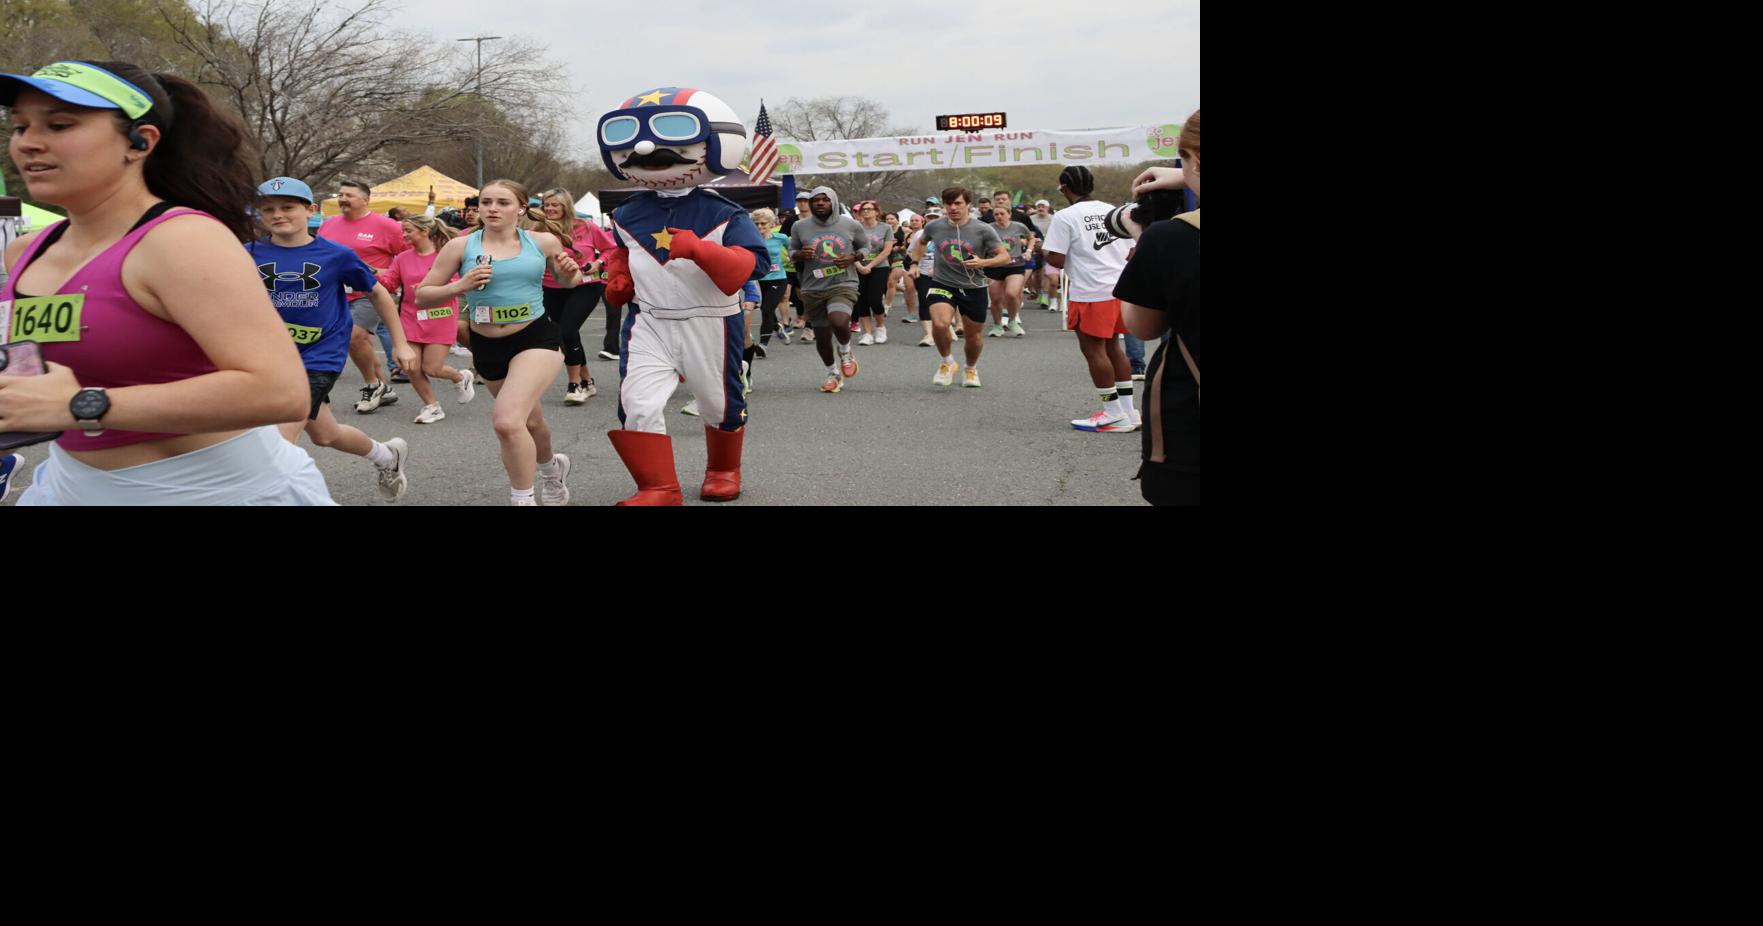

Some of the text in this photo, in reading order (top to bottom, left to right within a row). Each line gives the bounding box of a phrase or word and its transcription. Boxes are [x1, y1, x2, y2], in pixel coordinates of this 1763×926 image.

[948, 114, 1002, 128] 8:00:09
[899, 132, 1033, 145] RUN JEN RUN
[1152, 134, 1179, 150] je
[778, 155, 801, 163] en
[271, 291, 319, 301] NDER
[14, 301, 73, 337] 1640
[496, 306, 529, 319] 1102
[288, 327, 319, 341] 037
